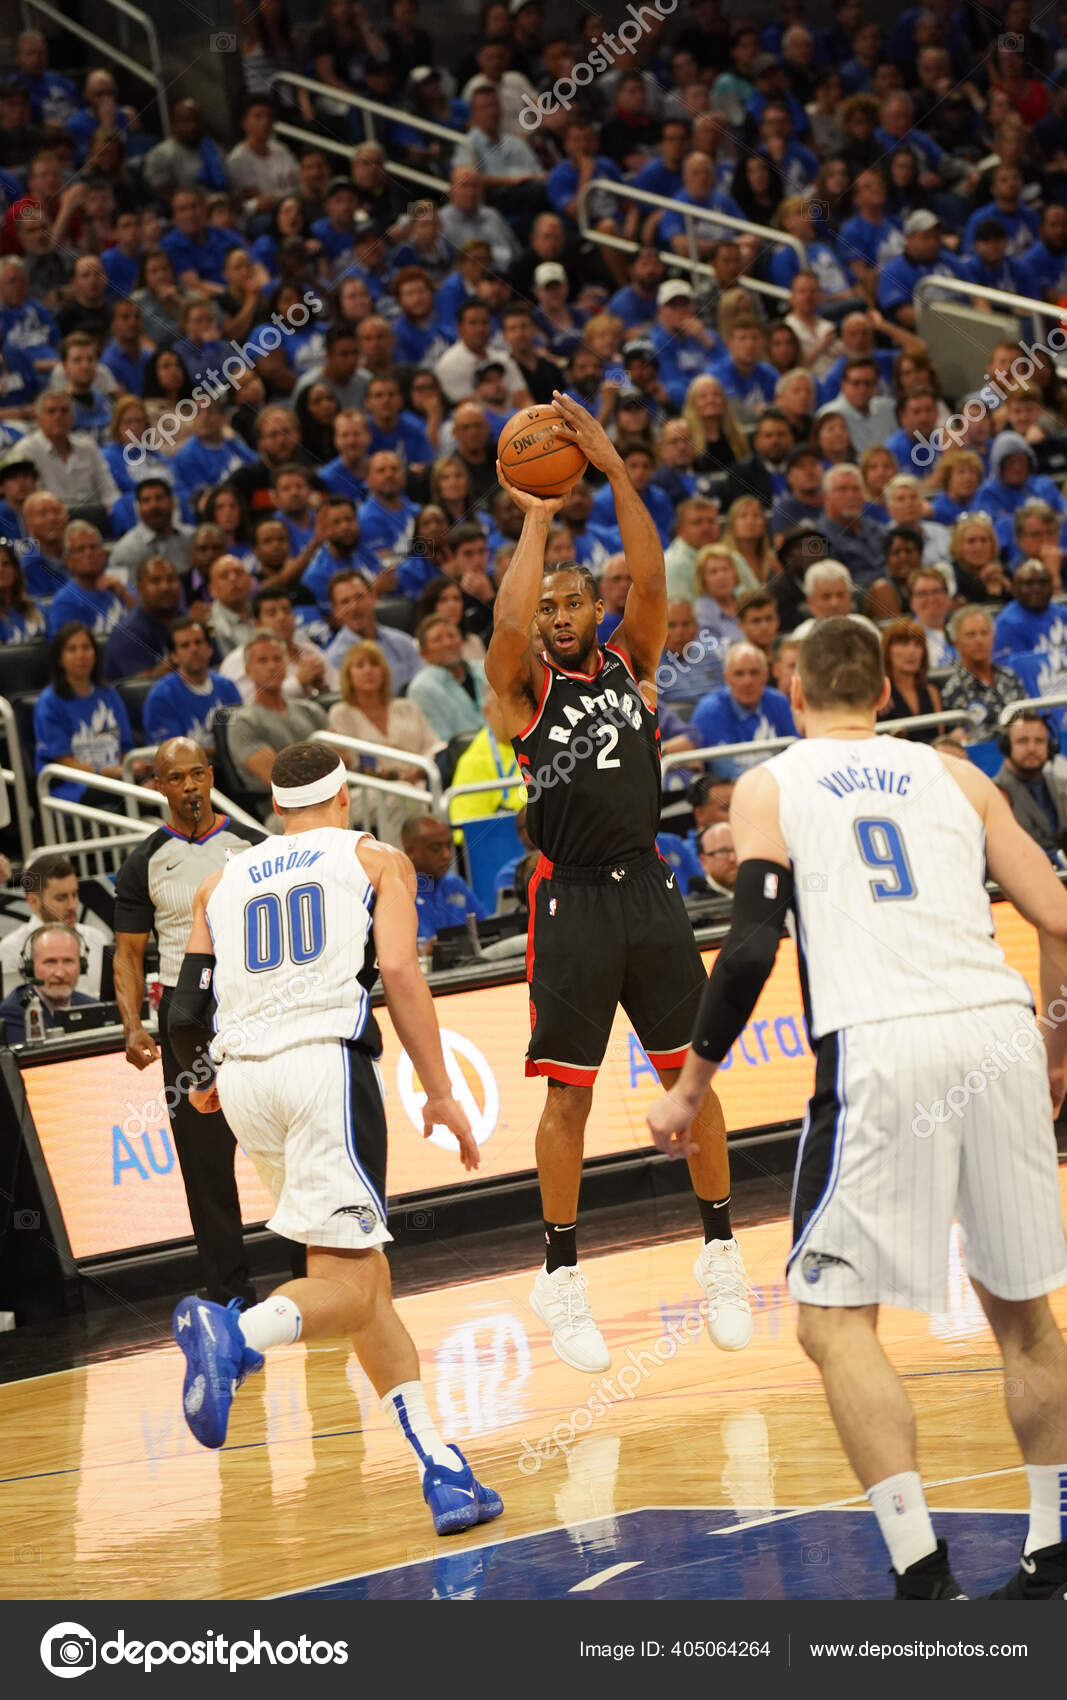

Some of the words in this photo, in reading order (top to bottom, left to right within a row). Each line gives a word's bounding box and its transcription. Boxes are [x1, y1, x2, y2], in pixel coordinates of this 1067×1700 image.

[548, 688, 643, 744] RAPTORS
[596, 724, 621, 769] 2
[248, 850, 325, 883] GORDON
[853, 816, 918, 902] 9
[244, 881, 326, 973] 00
